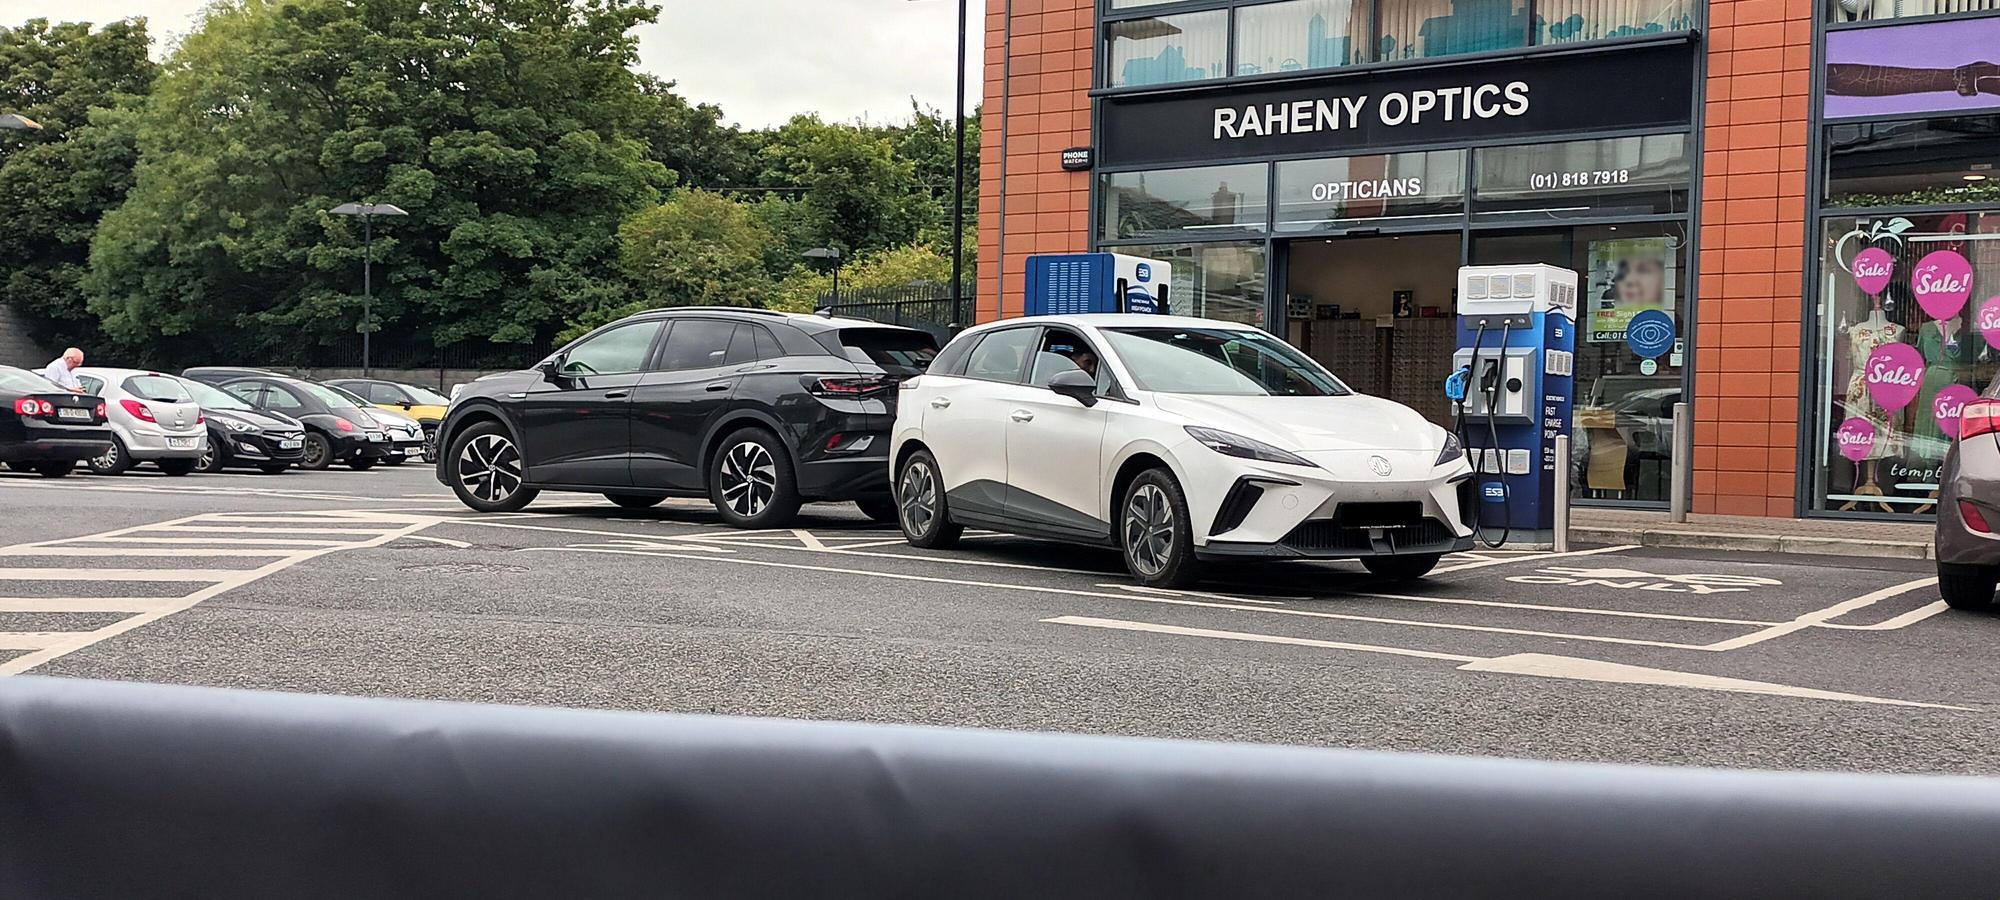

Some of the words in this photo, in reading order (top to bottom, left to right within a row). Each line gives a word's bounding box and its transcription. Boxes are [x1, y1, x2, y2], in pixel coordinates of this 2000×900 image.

[1213, 95, 1368, 140] RAHENY
[1379, 81, 1530, 126] OPTICS
[1063, 151, 1089, 159] PHONE
[1311, 177, 1421, 201] OPTICIANS
[1530, 172, 1558, 190] (01)
[1562, 172, 1588, 187] 818
[1593, 169, 1629, 185] 7918
[1855, 263, 1892, 278] Sale!
[1915, 273, 1971, 295] Sale!
[1867, 363, 1923, 387] Sale!
[1936, 402, 1965, 419] Sal
[1840, 431, 1874, 445] Sale!
[1485, 487, 1504, 497] ESB
[1504, 575, 1751, 595] ONLY
